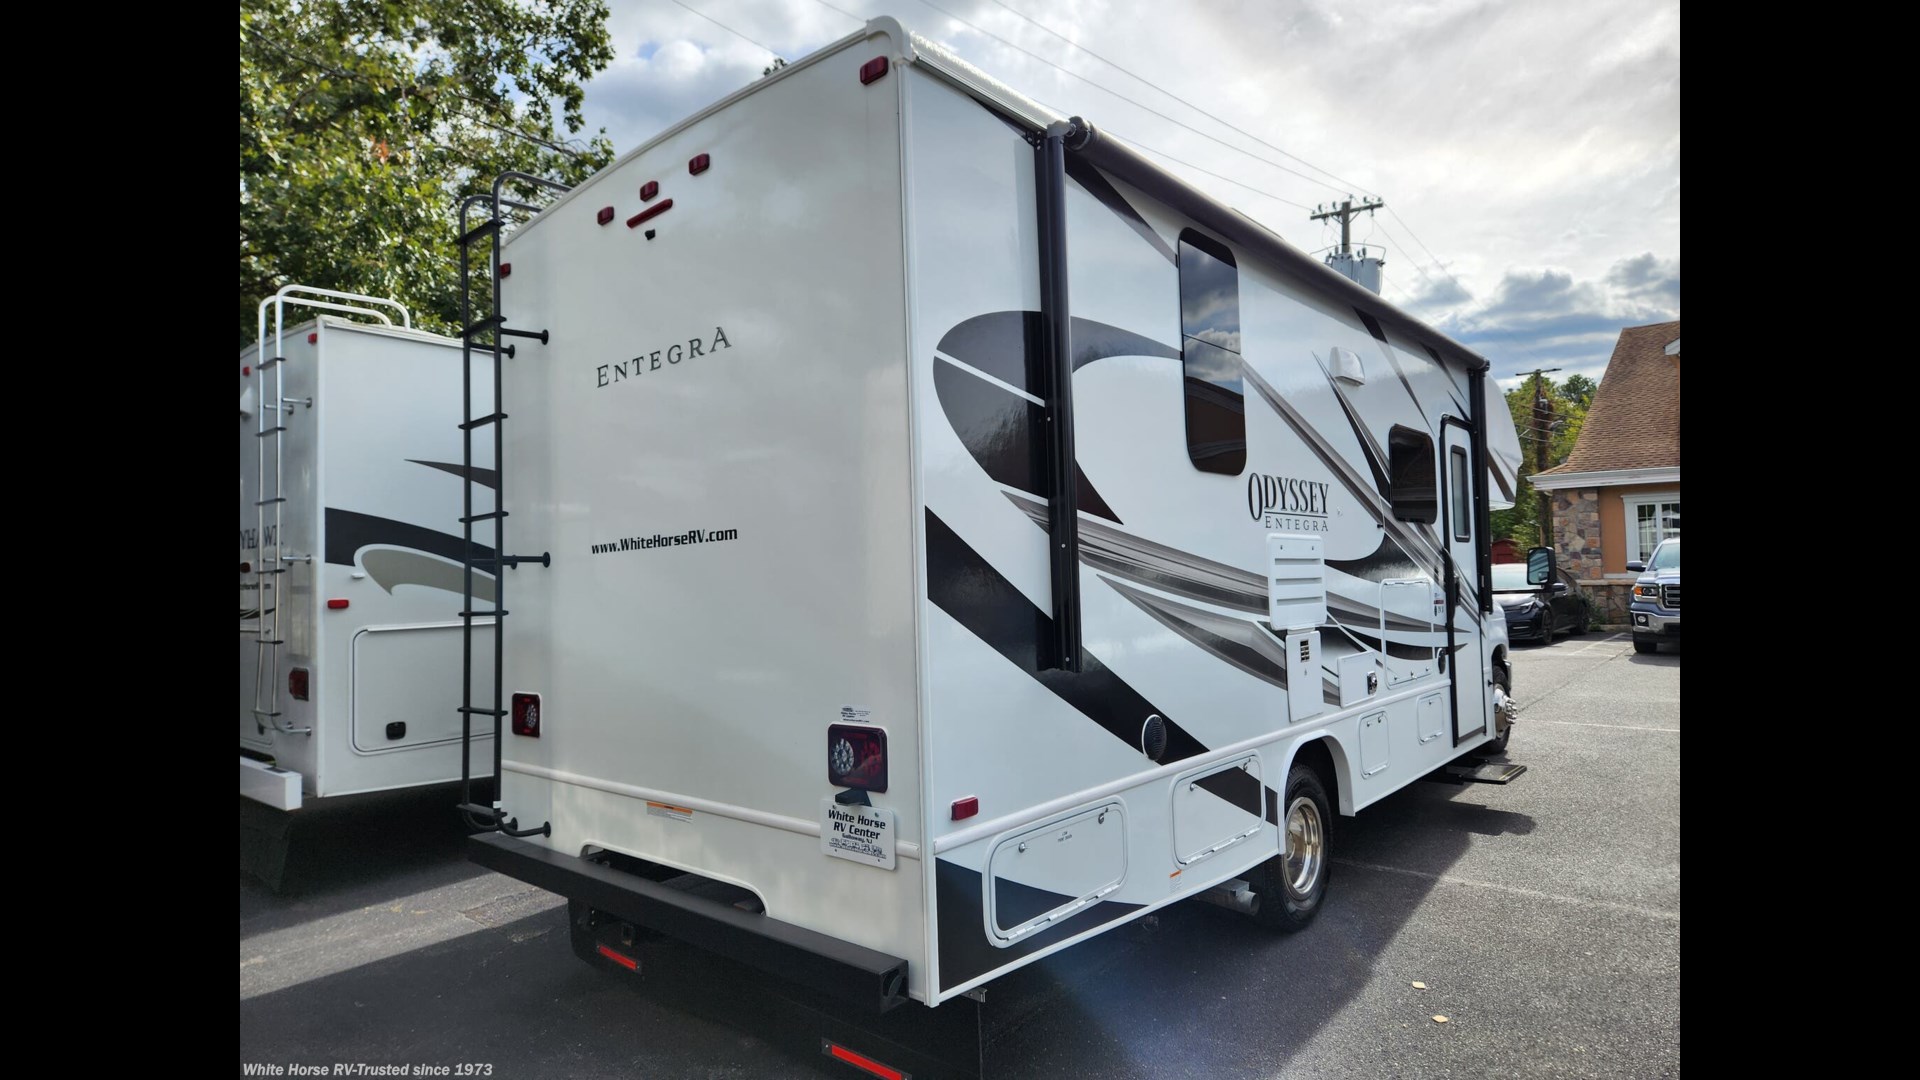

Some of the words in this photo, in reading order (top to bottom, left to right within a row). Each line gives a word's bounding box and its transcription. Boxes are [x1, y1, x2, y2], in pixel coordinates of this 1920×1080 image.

[597, 326, 732, 388] ENTEGRA
[1248, 472, 1329, 522] ODYSSEY
[1265, 516, 1329, 532] ENTEGRA
[591, 529, 738, 554] www.WhiteHorseRV.com
[828, 809, 855, 823] White
[857, 815, 886, 830] Horse
[833, 821, 847, 833] RV
[849, 824, 881, 840] Center
